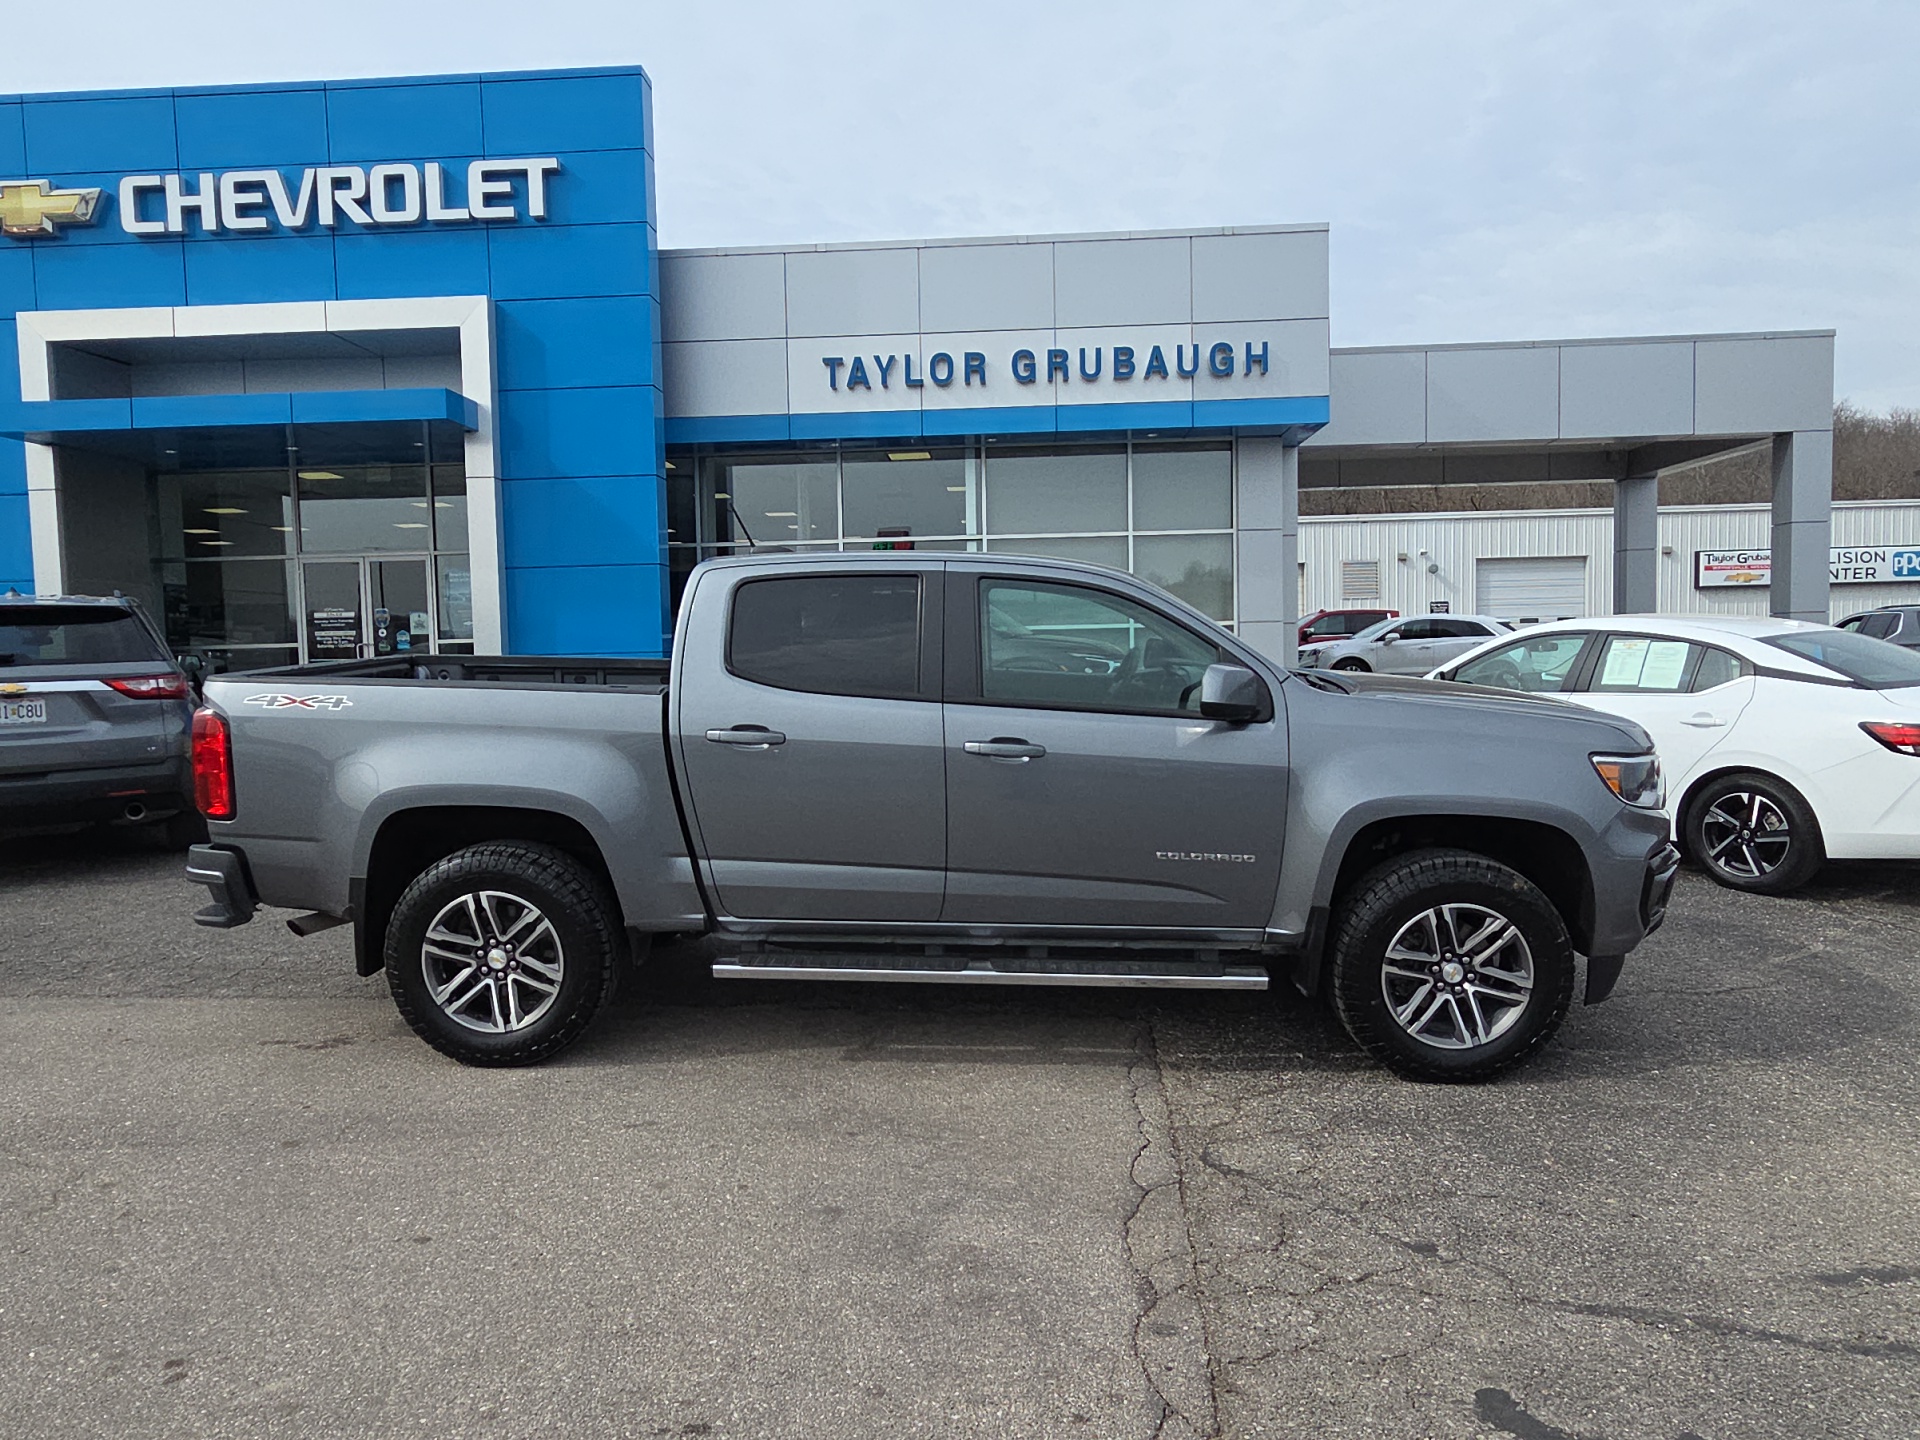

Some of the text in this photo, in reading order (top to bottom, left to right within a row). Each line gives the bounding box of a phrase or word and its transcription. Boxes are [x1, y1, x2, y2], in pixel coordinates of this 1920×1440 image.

[119, 157, 560, 235] CHEVROLET
[822, 341, 1270, 390] TAYLOR GRUBAUGH
[1704, 553, 1735, 564] Taylor
[1156, 851, 1256, 862] COLORADO
